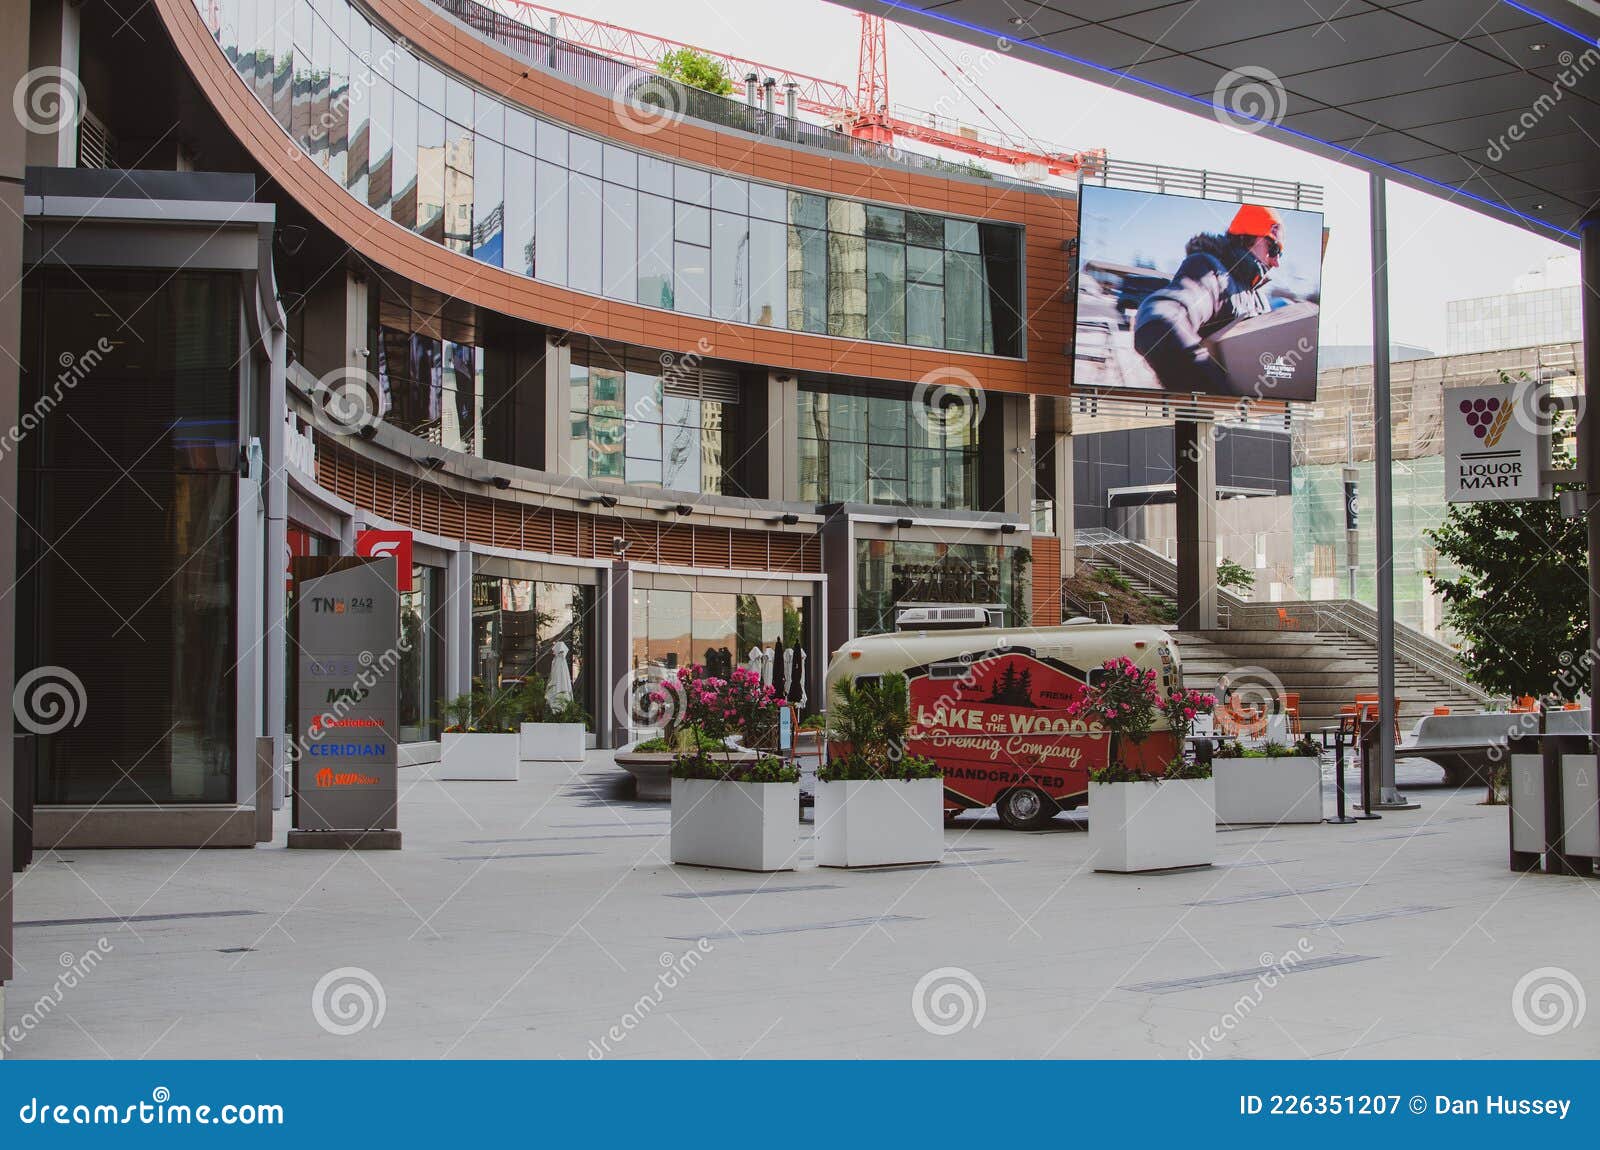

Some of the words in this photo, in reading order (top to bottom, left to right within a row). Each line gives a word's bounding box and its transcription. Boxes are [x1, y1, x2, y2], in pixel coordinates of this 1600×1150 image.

[1460, 462, 1522, 477] LIQUOR
[1460, 474, 1523, 490] MART
[956, 683, 985, 692] OCAL
[326, 688, 369, 703] MNP
[1039, 691, 1074, 702] FRESH
[917, 704, 984, 731] LAKE
[990, 713, 1006, 723] OF
[986, 722, 1008, 733] THE
[1009, 713, 1104, 740] WOODS
[309, 743, 385, 757] CERIDIAN
[930, 728, 1002, 760] Brewing
[1006, 736, 1083, 767] Company
[943, 766, 1065, 789] HANDCRAFTED
